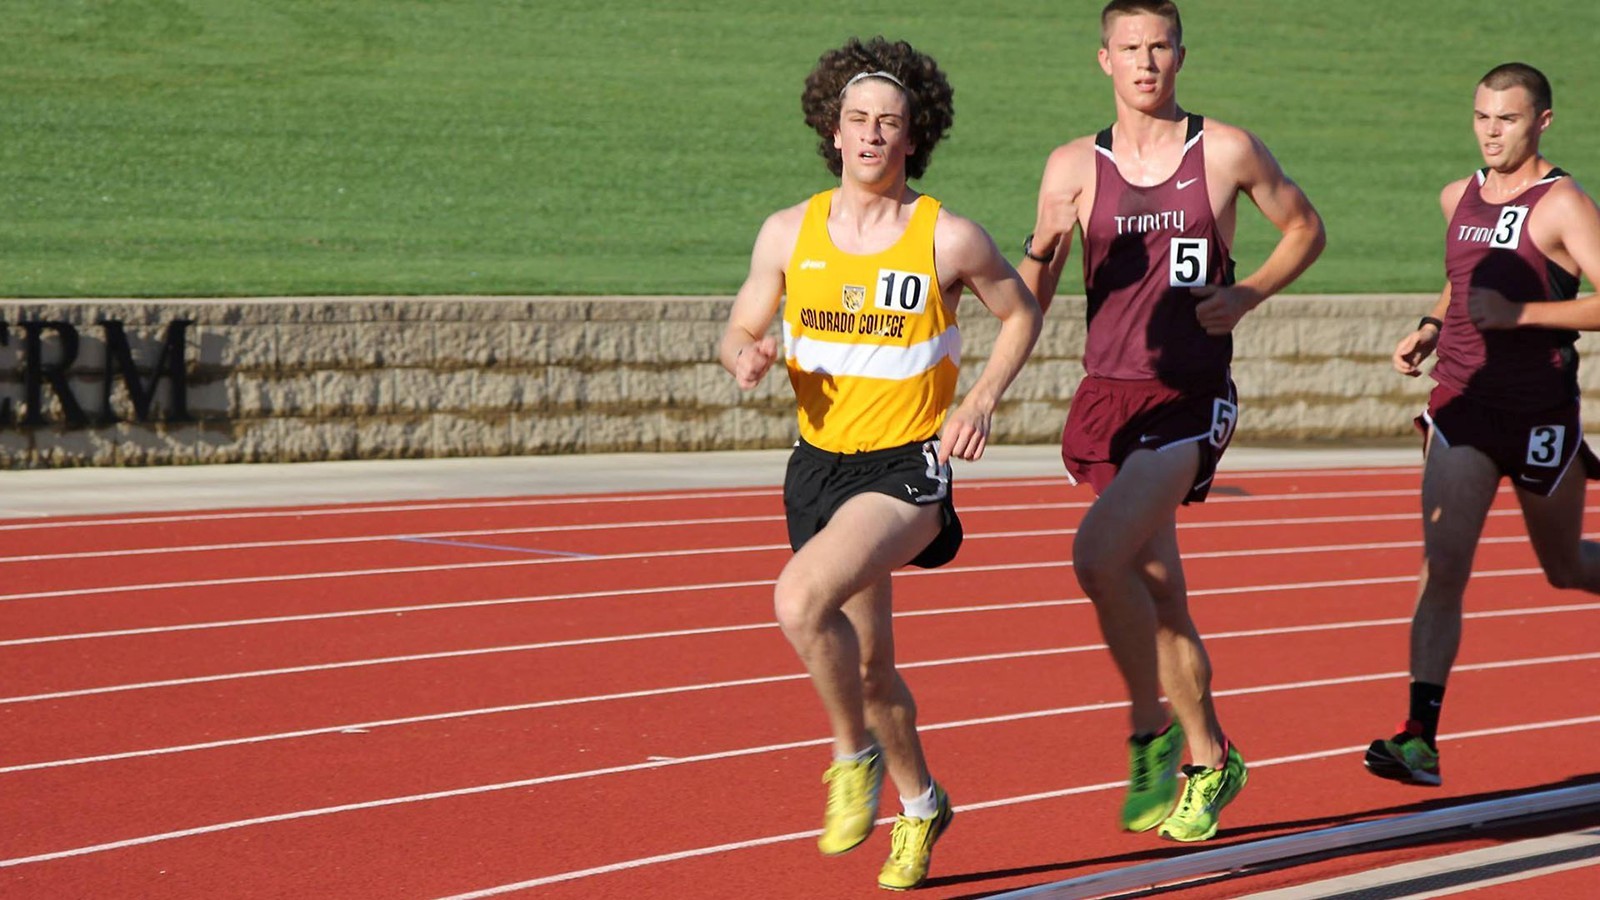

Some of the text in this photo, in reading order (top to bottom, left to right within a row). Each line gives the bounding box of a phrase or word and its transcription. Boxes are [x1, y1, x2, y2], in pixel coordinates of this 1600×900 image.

[1114, 210, 1185, 235] TRINITY
[1458, 225, 1495, 244] TRINI
[1495, 210, 1519, 244] 3
[1175, 242, 1200, 283] 5
[881, 272, 922, 310] 10
[800, 307, 906, 338] COLORADO COLLEGE
[0, 320, 197, 427] RM
[1213, 402, 1233, 444] 5
[1531, 427, 1557, 463] 3
